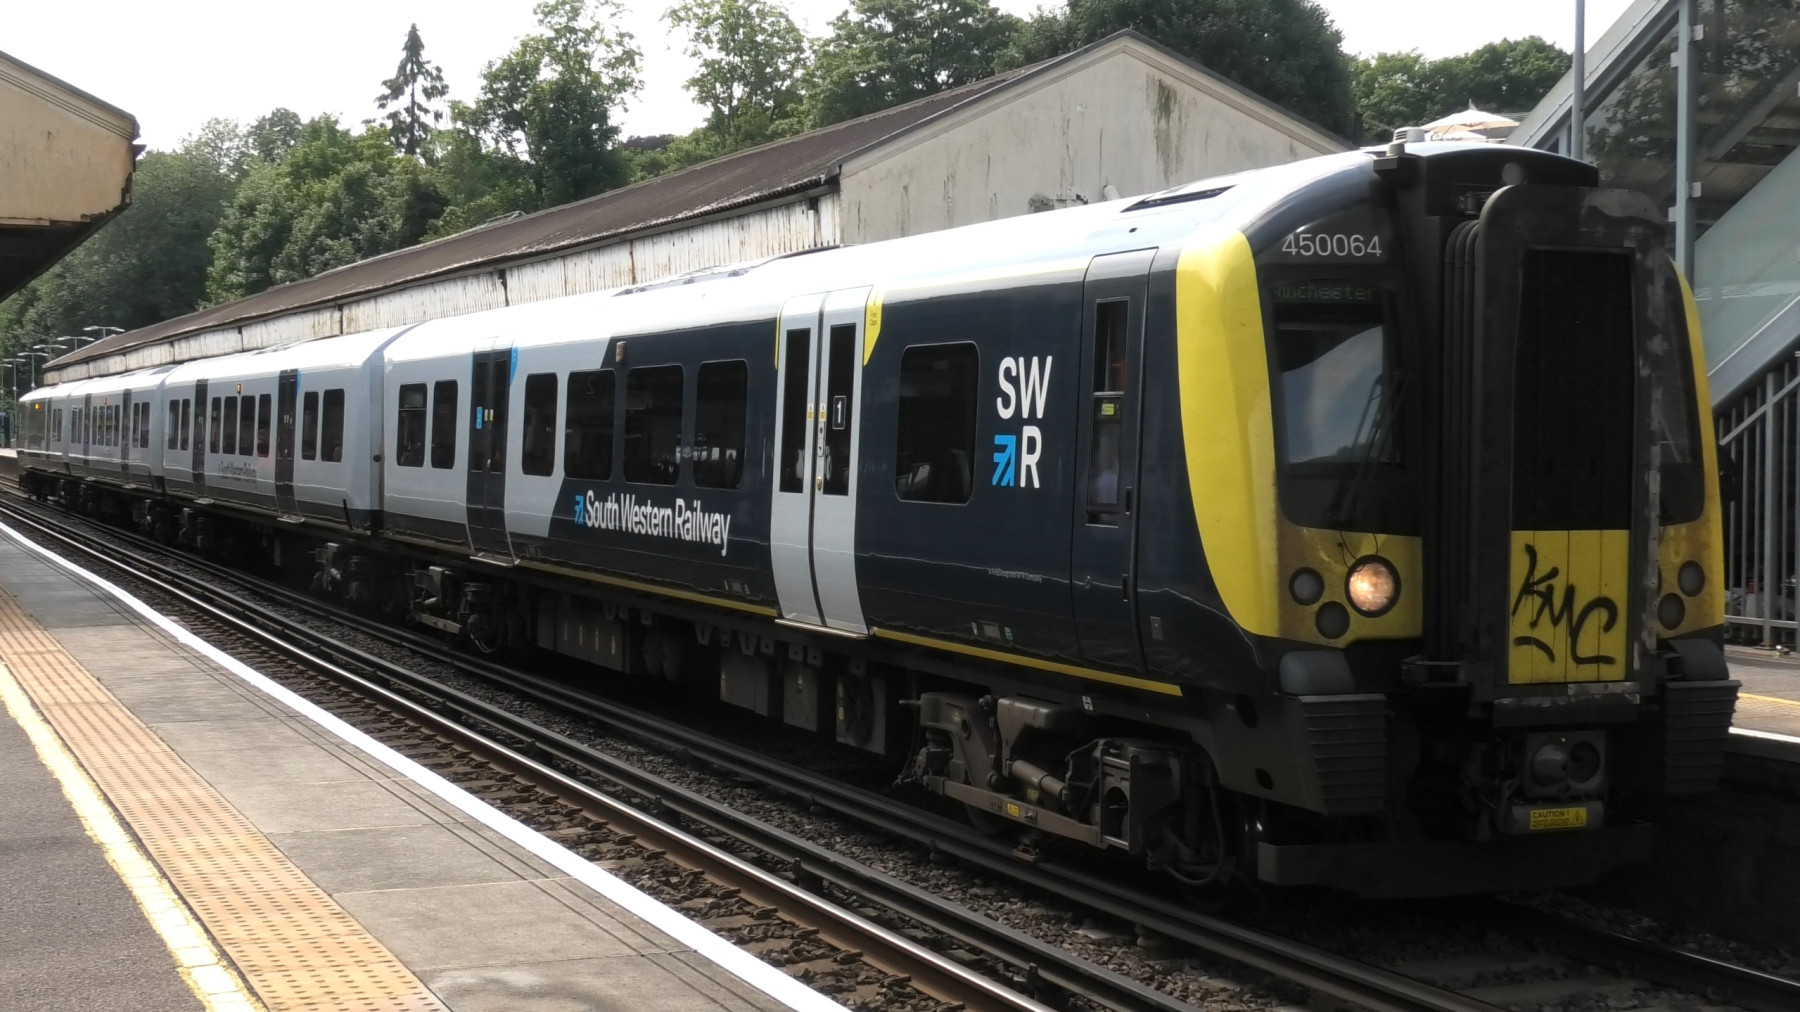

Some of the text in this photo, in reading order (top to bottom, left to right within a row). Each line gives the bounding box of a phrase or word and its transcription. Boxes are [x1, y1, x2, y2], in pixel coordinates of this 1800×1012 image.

[1281, 233, 1383, 257] 450064
[836, 400, 843, 424] 1
[996, 355, 1053, 420] SW
[1020, 425, 1042, 489] R
[585, 489, 731, 557] South Western Railway
